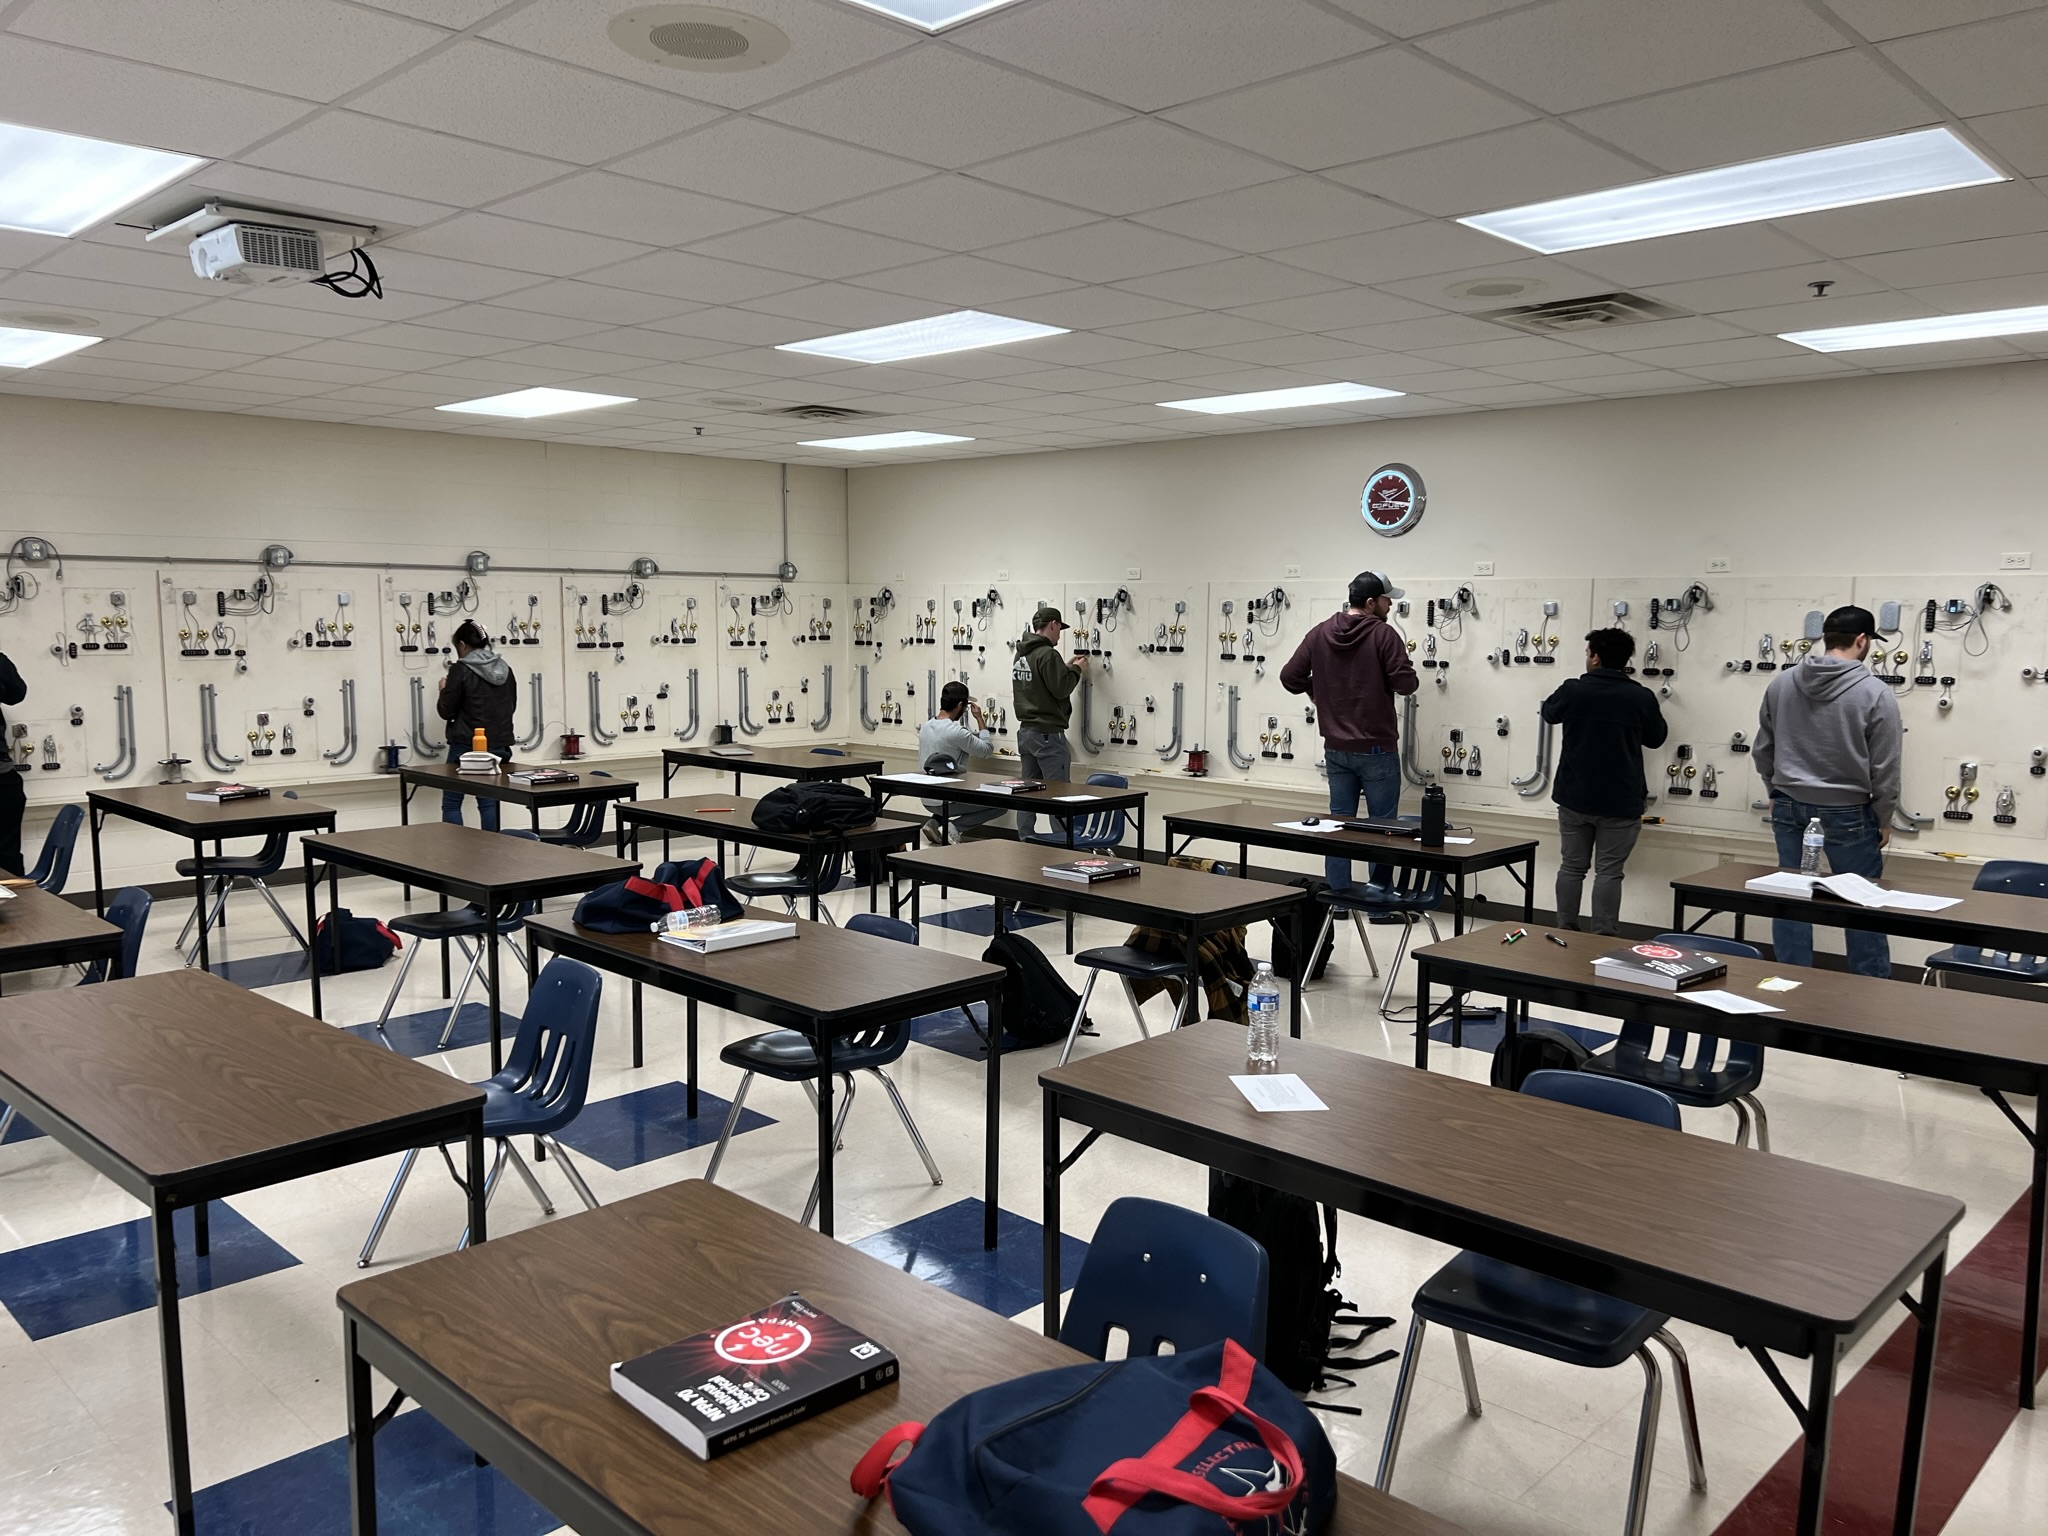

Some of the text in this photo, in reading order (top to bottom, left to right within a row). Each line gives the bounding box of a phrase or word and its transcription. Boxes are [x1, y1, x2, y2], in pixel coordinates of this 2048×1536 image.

[1012, 671, 1032, 681] KUIU
[738, 1327, 789, 1355] nec
[677, 1389, 726, 1422] NFPA 70
[697, 1383, 744, 1414] National
[707, 1375, 757, 1408] Electrical
